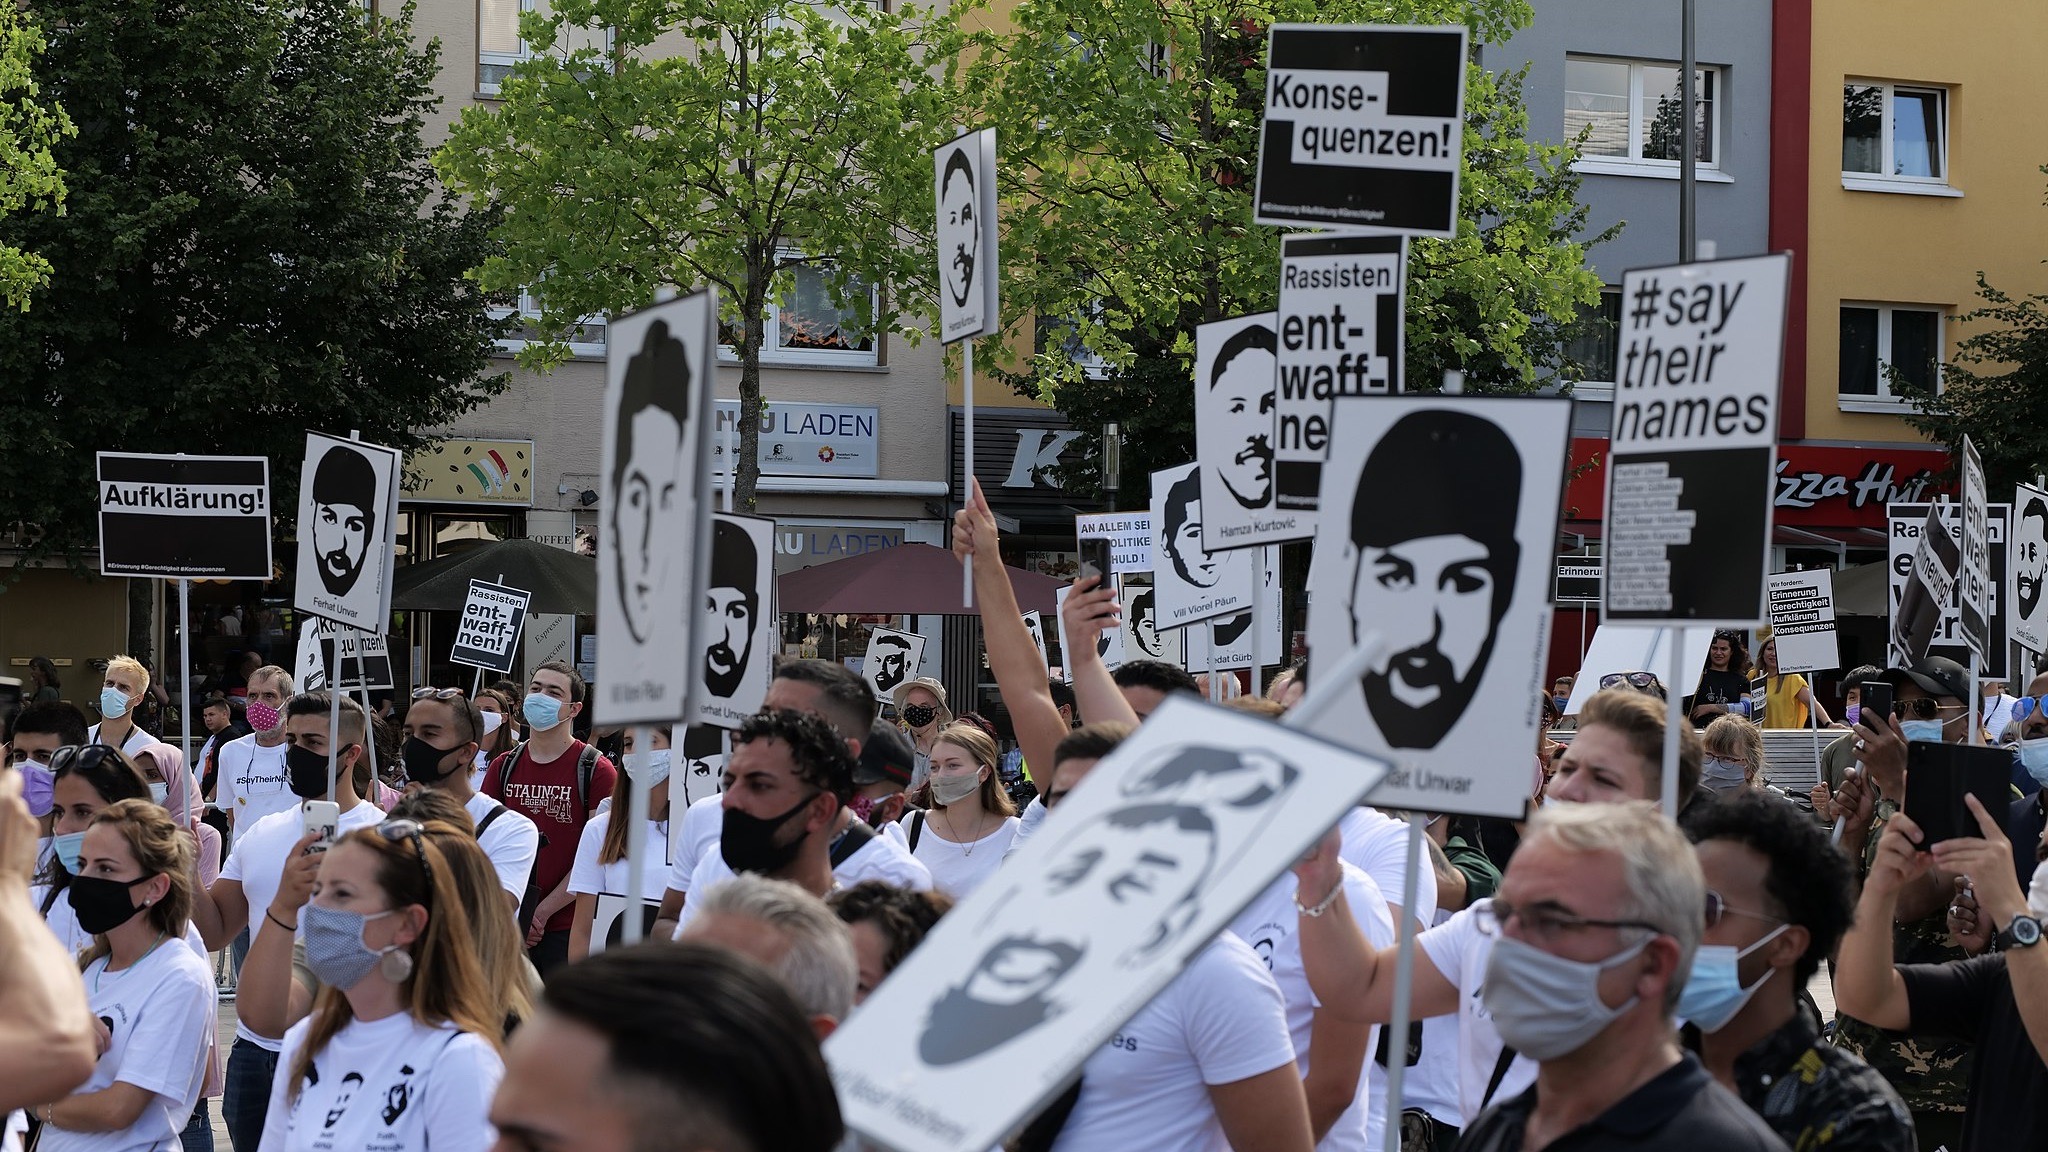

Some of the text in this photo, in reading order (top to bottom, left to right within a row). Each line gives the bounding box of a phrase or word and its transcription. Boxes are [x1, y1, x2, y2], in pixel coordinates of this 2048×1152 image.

[1272, 75, 1378, 110] Konse-
[1302, 123, 1450, 160] quenzen!
[1285, 263, 1390, 290] Rassisten
[1631, 278, 1746, 335] #say
[1282, 304, 1363, 350] ent-
[1624, 330, 1726, 388] their
[1281, 353, 1385, 400] waff-
[784, 413, 873, 437] LADEN
[1616, 394, 1768, 441] names
[1280, 413, 1328, 450] ne
[1774, 460, 1930, 508] izza Hut
[104, 484, 265, 515] Aufklärung!
[1081, 520, 1150, 533] AN ALLEM SEI
[1221, 525, 1252, 538] Hamza
[528, 535, 571, 545] COFFEE
[811, 533, 898, 555] LADEN
[1110, 537, 1150, 547] OLITIKE
[107, 563, 140, 571] #Erinnerung
[141, 564, 179, 572] #Gerechtigkeit
[1111, 554, 1138, 564] HULD
[1559, 567, 1601, 576] Erinneru
[470, 589, 522, 608] Rassisten
[1771, 588, 1817, 600] Erinnerung
[313, 597, 358, 619] Ferhat Unvar
[466, 603, 507, 621] ent-
[1173, 607, 1187, 619] Vili
[1188, 601, 1213, 614] Viorel
[1772, 598, 1829, 611] Gerechtigkeit
[463, 616, 513, 637] waff-
[1773, 612, 1818, 624] Aufklärung
[535, 616, 563, 643] Espresso
[1774, 622, 1835, 635] Konsequenzen
[341, 635, 384, 656] qunzen!
[458, 632, 504, 652] nen!
[530, 640, 566, 677] Cppuccino
[1232, 653, 1252, 662] Gürb
[701, 705, 721, 717] erhat
[236, 775, 287, 785] #SayTheirNa
[506, 784, 572, 800] STAUNCH
